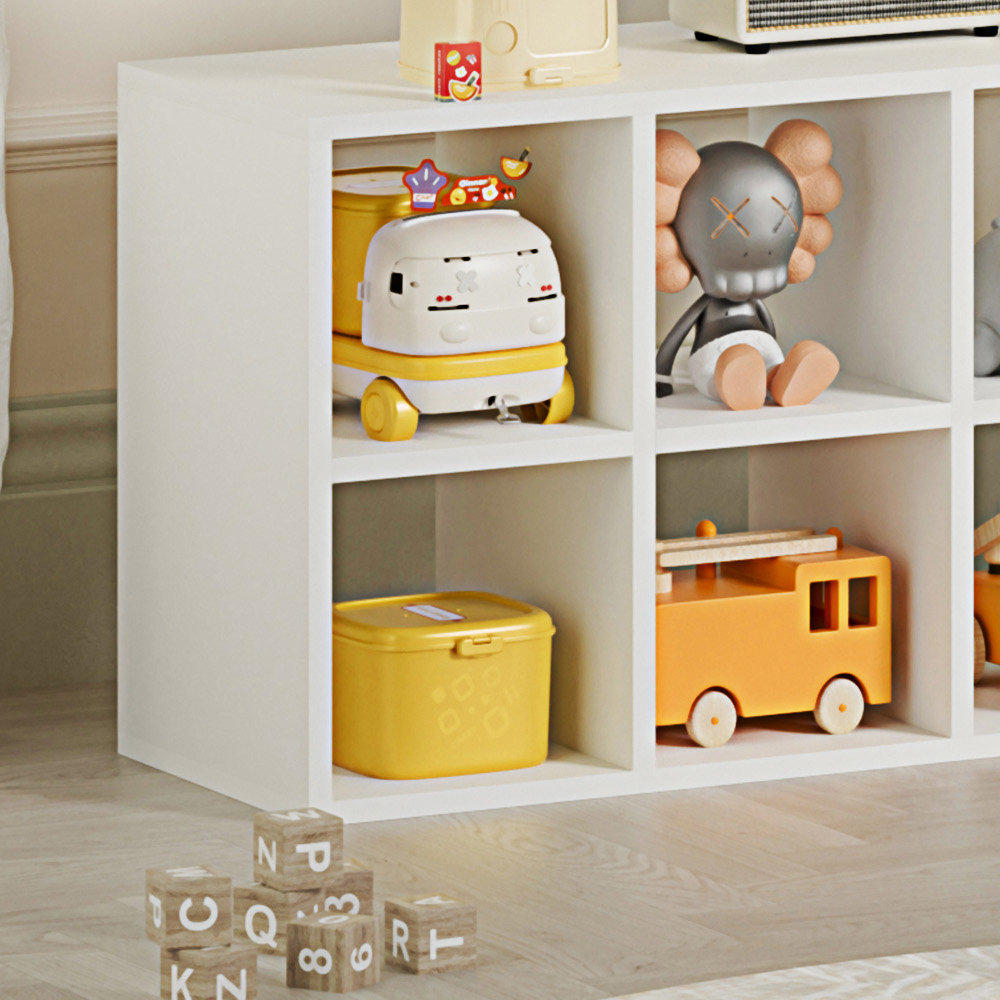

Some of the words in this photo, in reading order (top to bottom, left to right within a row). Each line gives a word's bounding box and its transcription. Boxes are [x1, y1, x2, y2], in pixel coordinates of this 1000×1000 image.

[295, 841, 331, 873] P
[178, 896, 219, 932] C
[244, 904, 278, 949] Q
[392, 918, 411, 963] R
[429, 928, 465, 961] T
[298, 947, 333, 976] 8
[170, 964, 194, 1000] K
